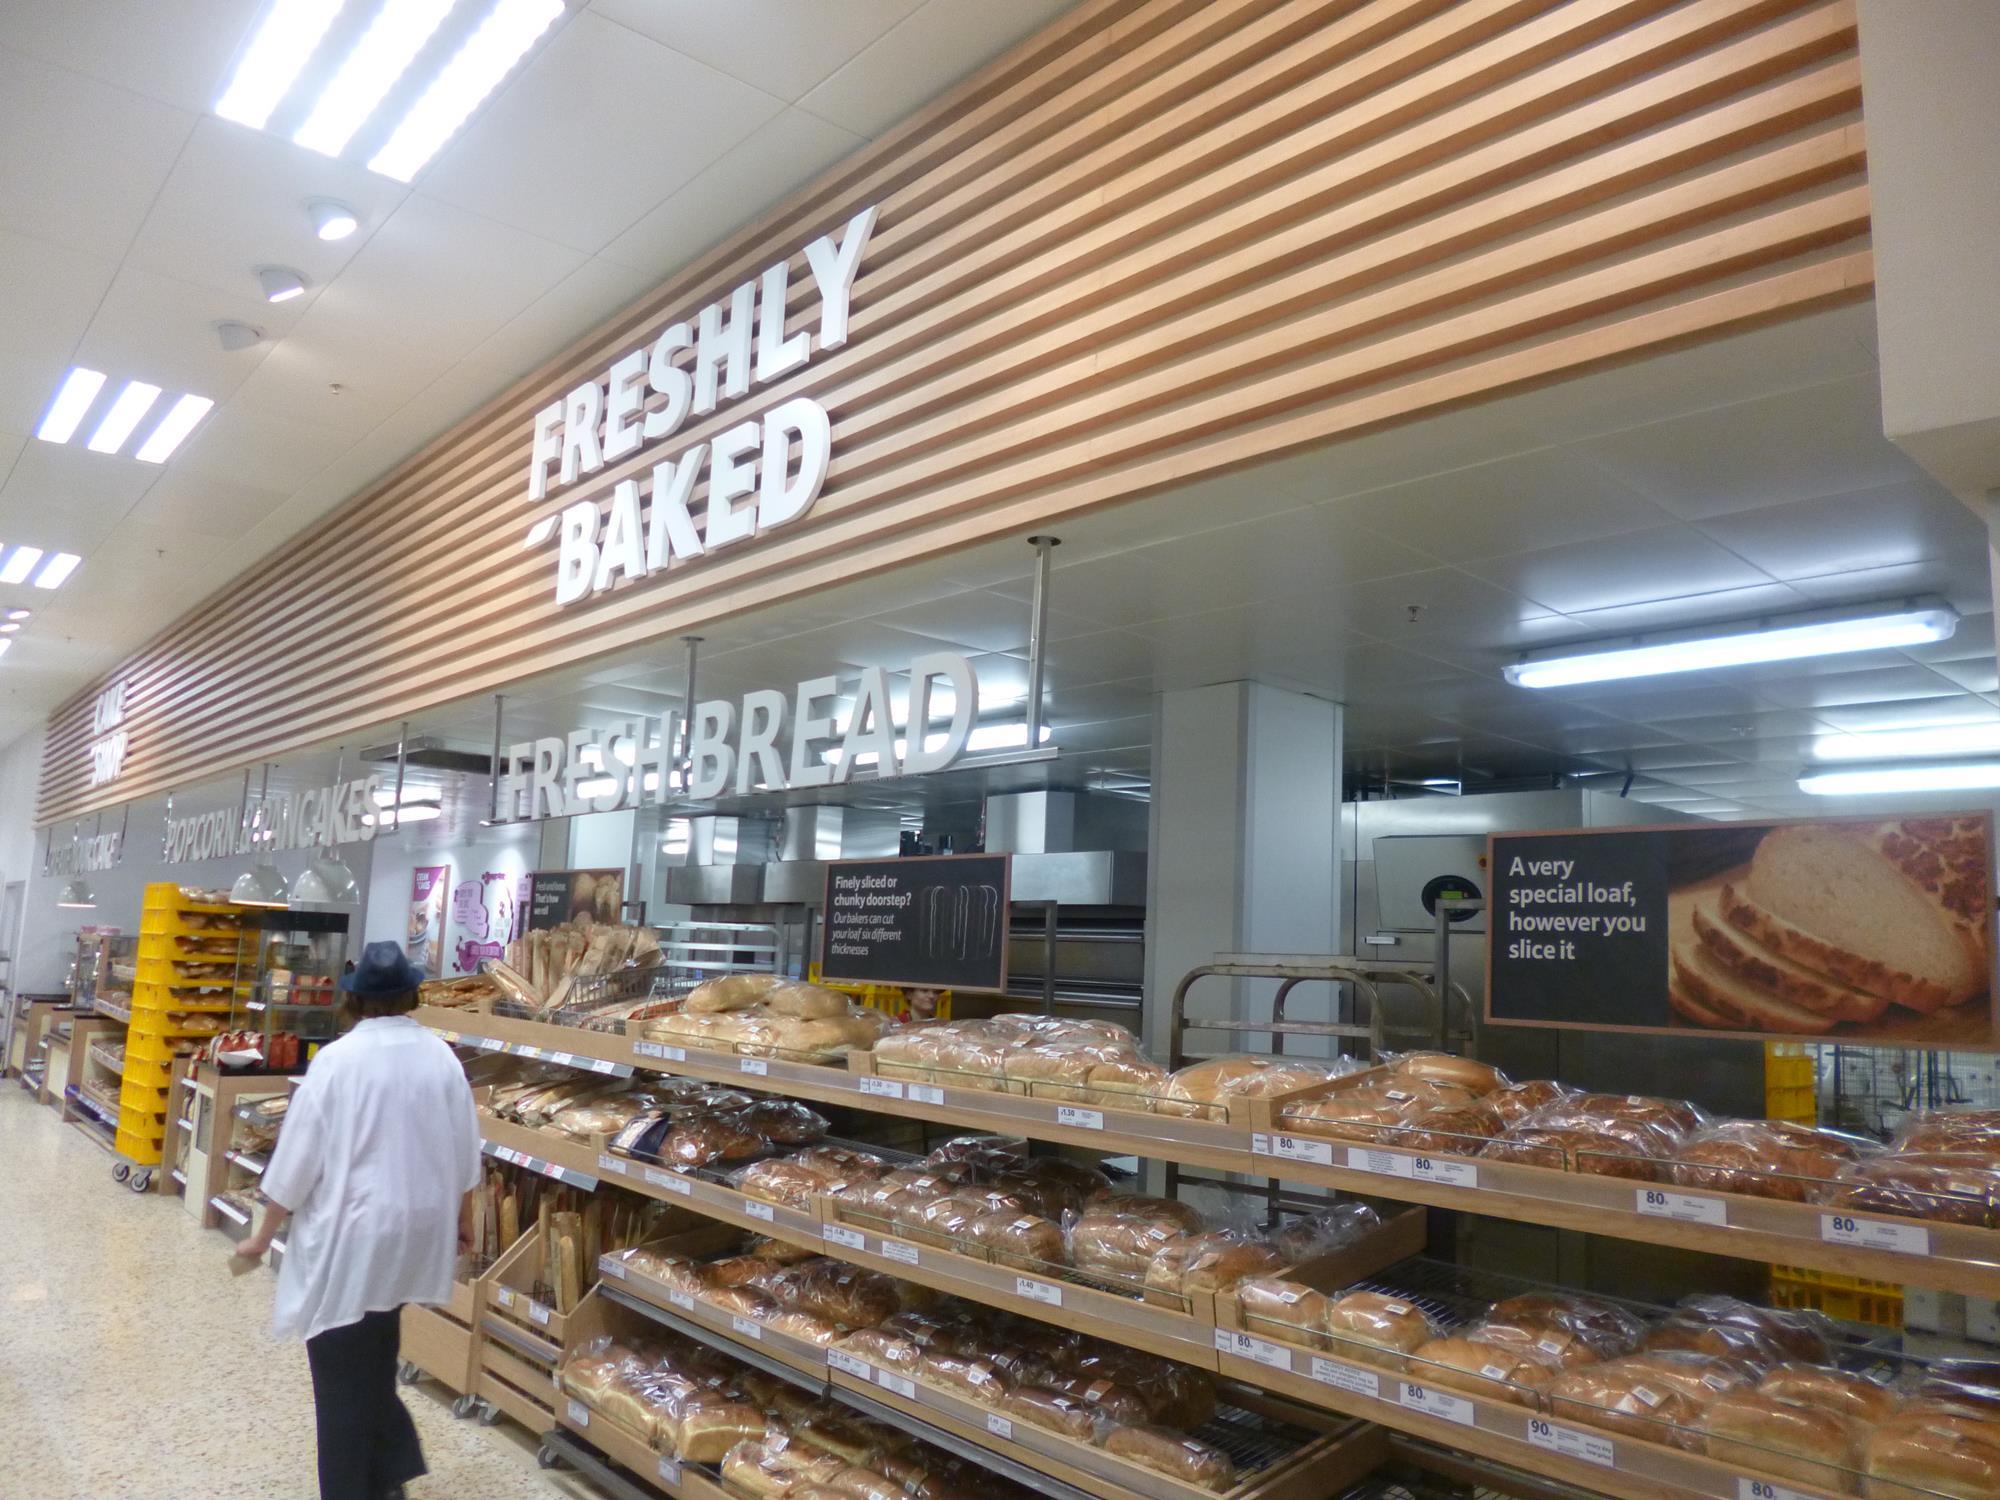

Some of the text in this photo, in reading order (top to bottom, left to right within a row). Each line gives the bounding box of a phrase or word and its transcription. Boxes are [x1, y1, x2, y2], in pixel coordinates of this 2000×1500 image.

[528, 204, 879, 501] FRESHLY
[545, 397, 832, 606] BAKED
[506, 652, 979, 822] FRESH BREAD
[165, 806, 241, 863] POPCORN
[257, 774, 382, 851] PANCAKES
[1509, 856, 1574, 880] A very
[835, 874, 898, 892] Finely sliced or
[1509, 881, 1637, 908] special loaf,
[834, 892, 912, 909] chunky doorstep?
[834, 911, 895, 924] Our bakers can cut
[1509, 910, 1646, 936] however you
[832, 927, 902, 942] your loaf six different
[831, 942, 869, 956] thicknesses
[1509, 938, 1576, 960] slice it
